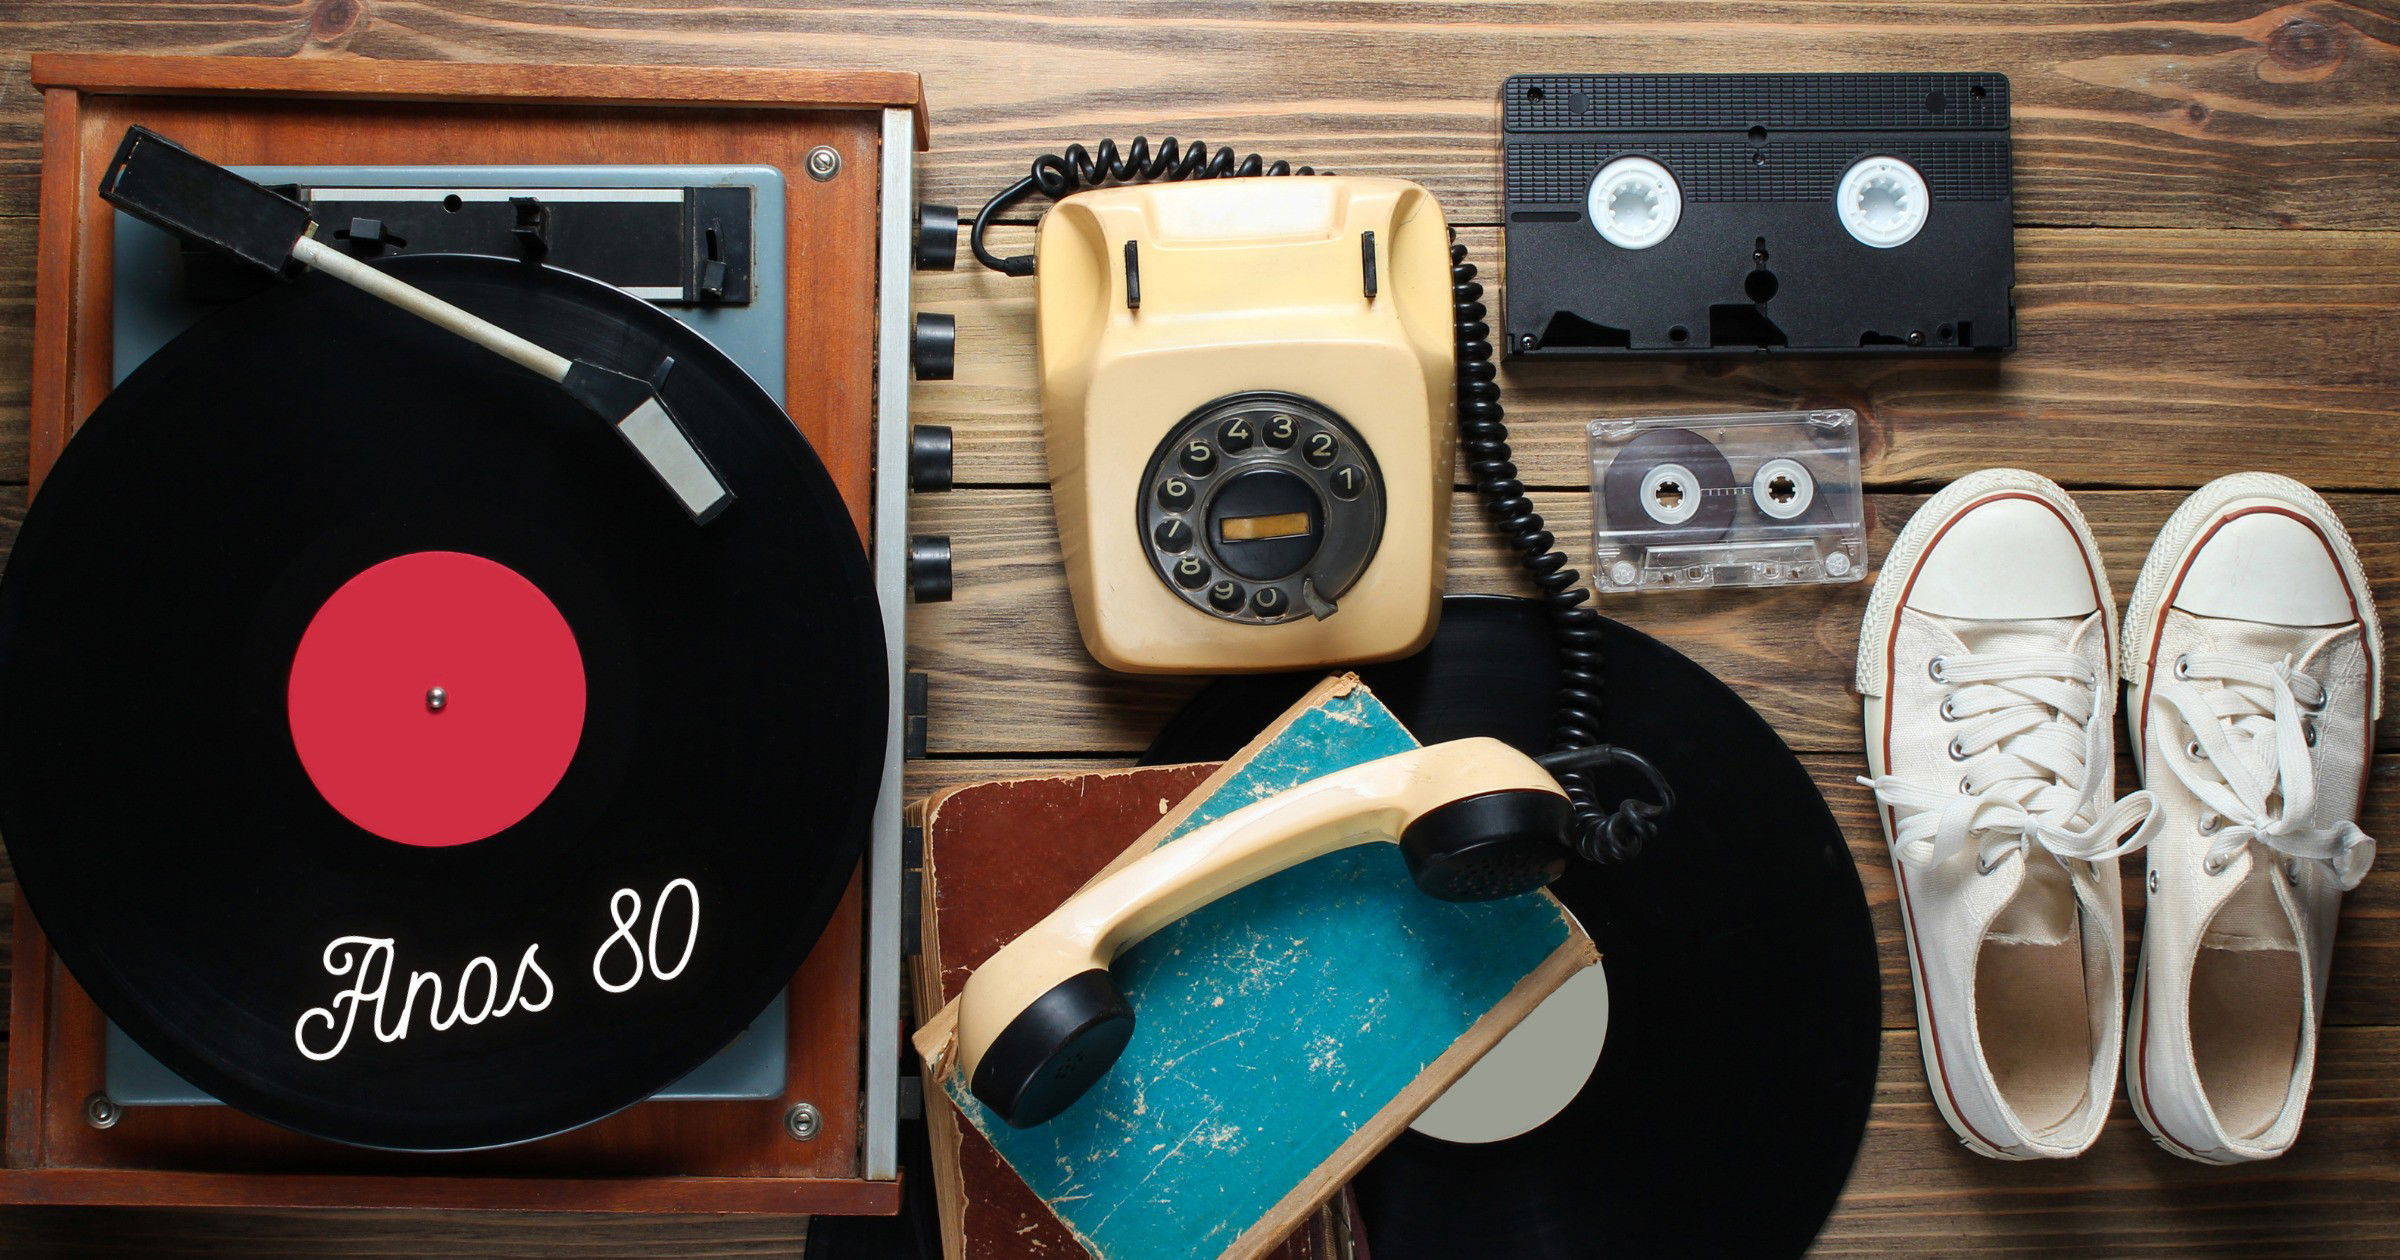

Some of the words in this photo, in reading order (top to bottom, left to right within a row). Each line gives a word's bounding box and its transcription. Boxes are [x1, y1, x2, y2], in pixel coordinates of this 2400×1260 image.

[1228, 418, 1249, 440] 4
[1273, 414, 1292, 439] 3
[1190, 441, 1211, 462] 5
[1312, 433, 1331, 456] 2
[1166, 478, 1187, 497] 6
[1339, 467, 1353, 490] 1
[1180, 557, 1200, 575] 8
[1215, 582, 1235, 600] 9
[1256, 588, 1277, 608] 0
